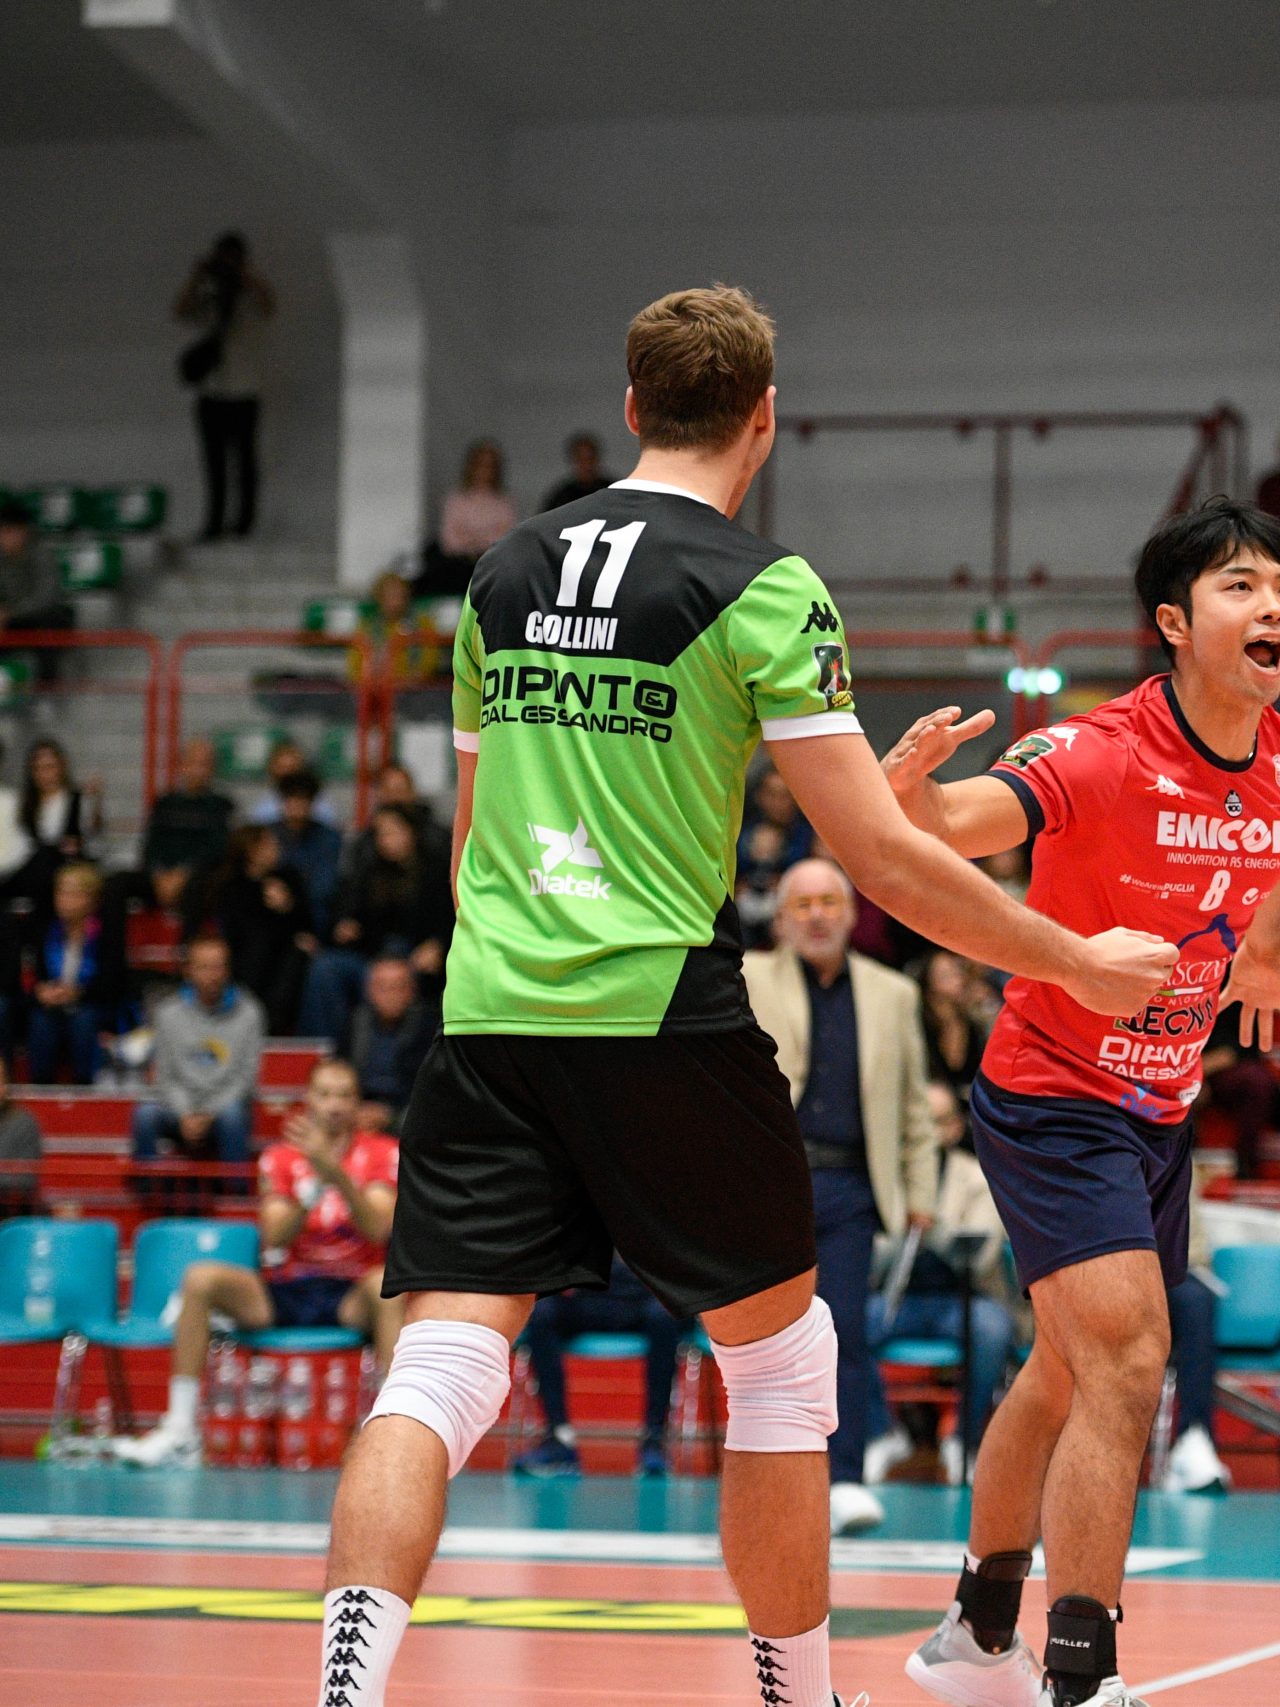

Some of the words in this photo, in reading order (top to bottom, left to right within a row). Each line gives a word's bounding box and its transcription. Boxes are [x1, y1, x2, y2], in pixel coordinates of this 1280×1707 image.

[556, 519, 647, 608] 11
[525, 610, 618, 650] GOLLINI
[481, 704, 672, 743] DALESSANDRO
[1167, 852, 1228, 867] INNOVATION
[1230, 856, 1242, 868] AS
[528, 869, 610, 901] Diatek
[1198, 869, 1232, 911] 8
